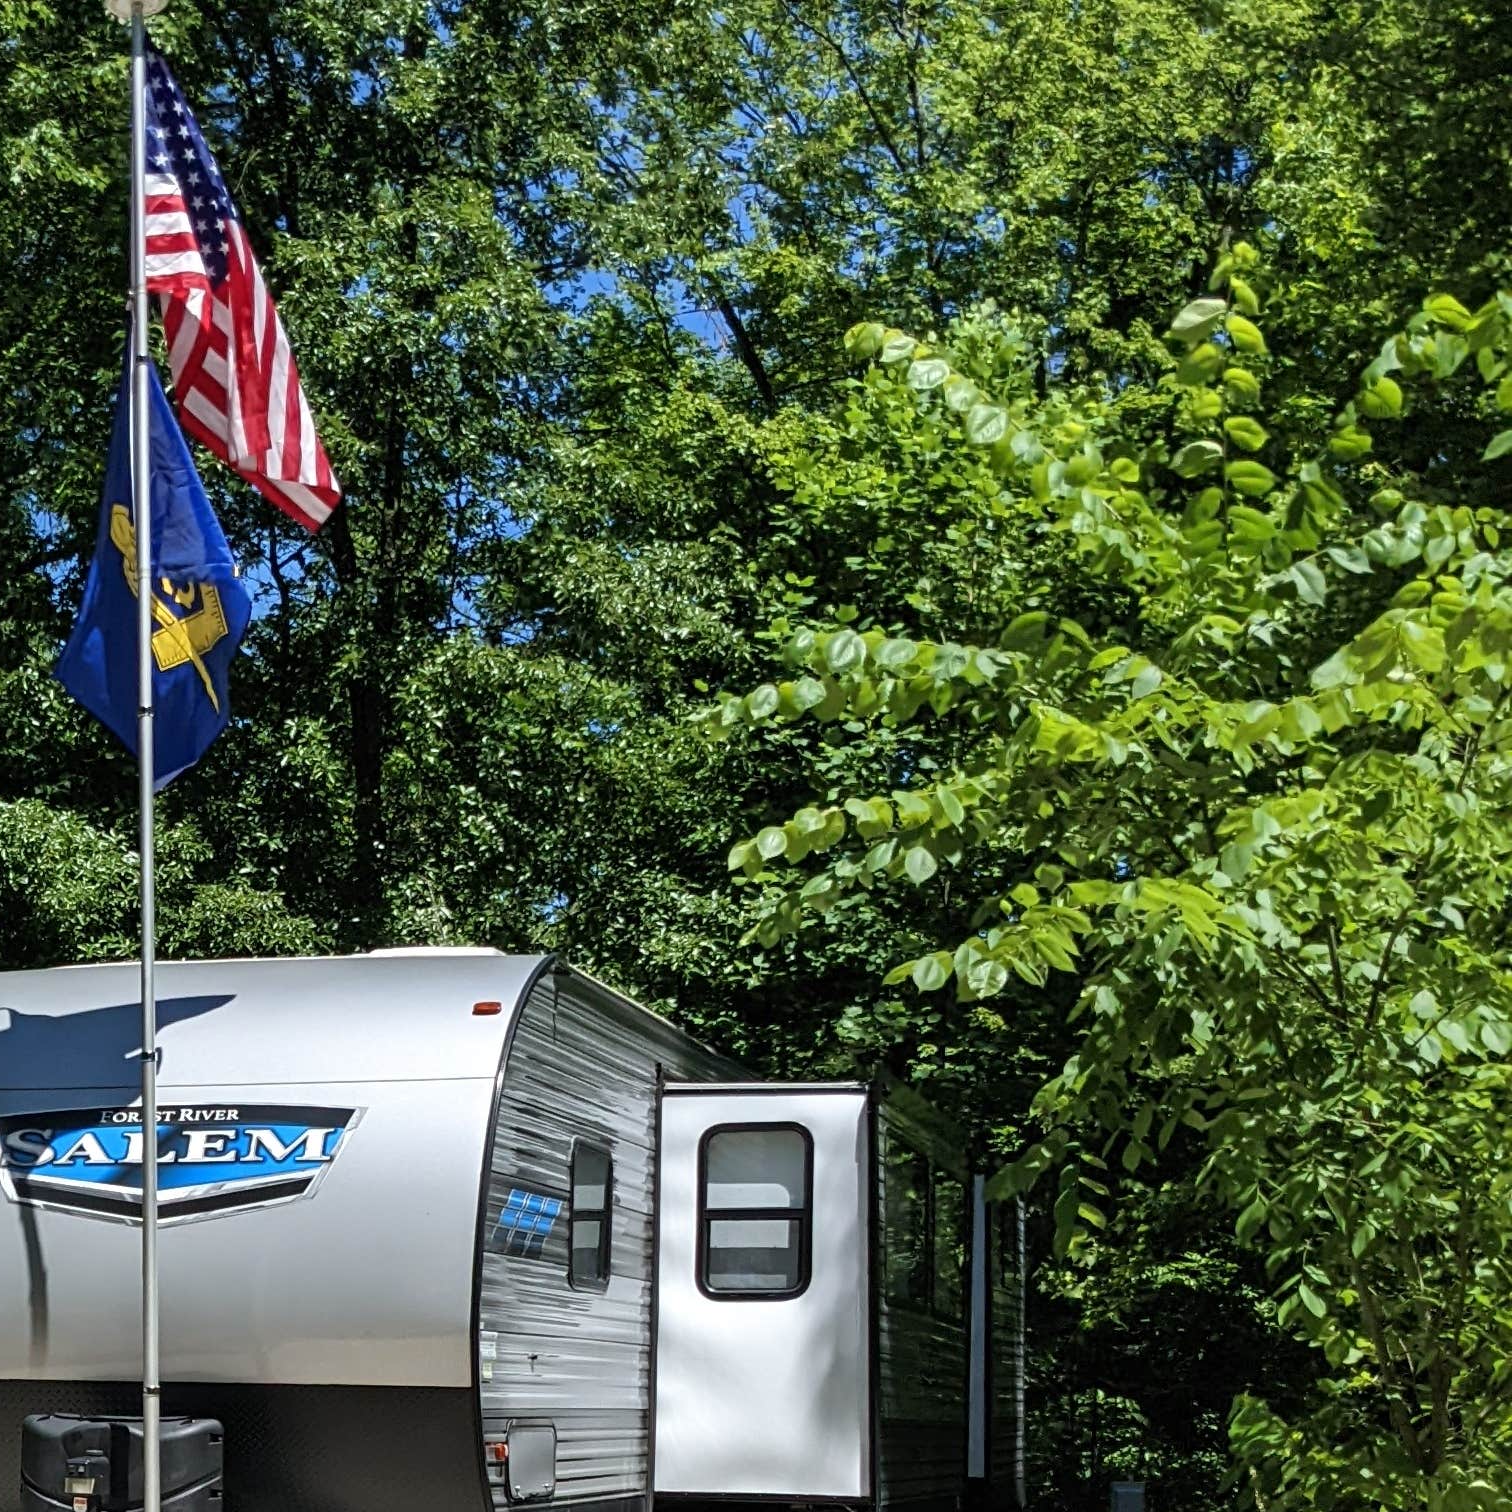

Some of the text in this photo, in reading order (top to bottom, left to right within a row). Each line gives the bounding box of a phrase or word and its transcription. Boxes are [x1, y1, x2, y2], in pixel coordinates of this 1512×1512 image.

[99, 1107, 240, 1124] FORST RIVER
[0, 1127, 336, 1167] SALEM
